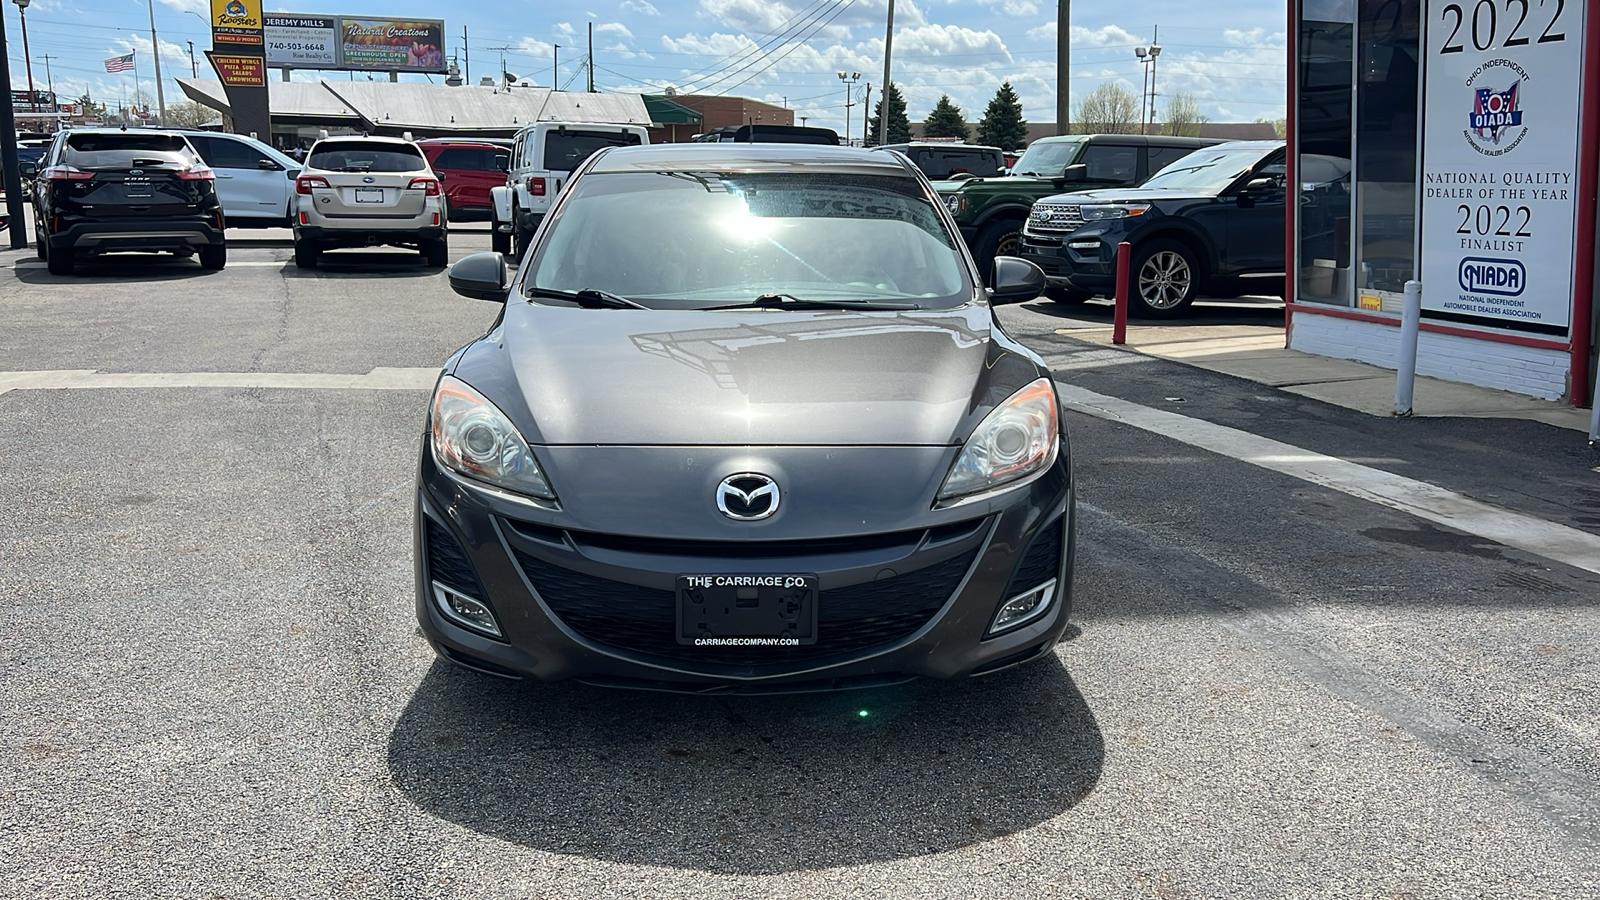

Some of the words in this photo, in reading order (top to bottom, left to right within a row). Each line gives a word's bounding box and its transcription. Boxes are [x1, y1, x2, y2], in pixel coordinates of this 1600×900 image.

[266, 18, 298, 26] JEREMY
[300, 19, 324, 27] MILLS
[1440, 0, 1565, 54] 2022
[347, 24, 384, 36] Natural
[386, 26, 429, 37] Creations
[269, 42, 325, 51] 740-503-6648
[1466, 67, 1482, 87] OHIO
[1482, 59, 1530, 82] INDEPENDENT
[1475, 112, 1513, 127] OIADA
[1463, 130, 1485, 155] AUTOMOBILE
[1484, 149, 1503, 157] DEALERS
[1503, 126, 1529, 154] ASSOCIATION
[1426, 173, 1496, 184] NATIONAL
[1502, 172, 1571, 186] QUALITY
[1427, 188, 1473, 199] DEALER
[1478, 188, 1494, 199] OF
[1500, 189, 1526, 200] THE
[1532, 189, 1568, 200] YEAR
[1456, 204, 1532, 237] 2022
[1460, 239, 1524, 252] FINALIST
[1464, 265, 1519, 291] NIADA
[1458, 295, 1485, 304] NATIONAL
[1486, 297, 1525, 307] INDEPENDENT
[1443, 302, 1477, 312] AUTOMOBILE
[1478, 305, 1501, 314] DEALERS
[1502, 308, 1542, 319] ASSOCIATION
[687, 577, 713, 587] THE
[715, 576, 783, 587] CARRIAGE
[785, 577, 808, 587] CO.
[694, 638, 799, 646] CARRIAGECOMPANY.COM
